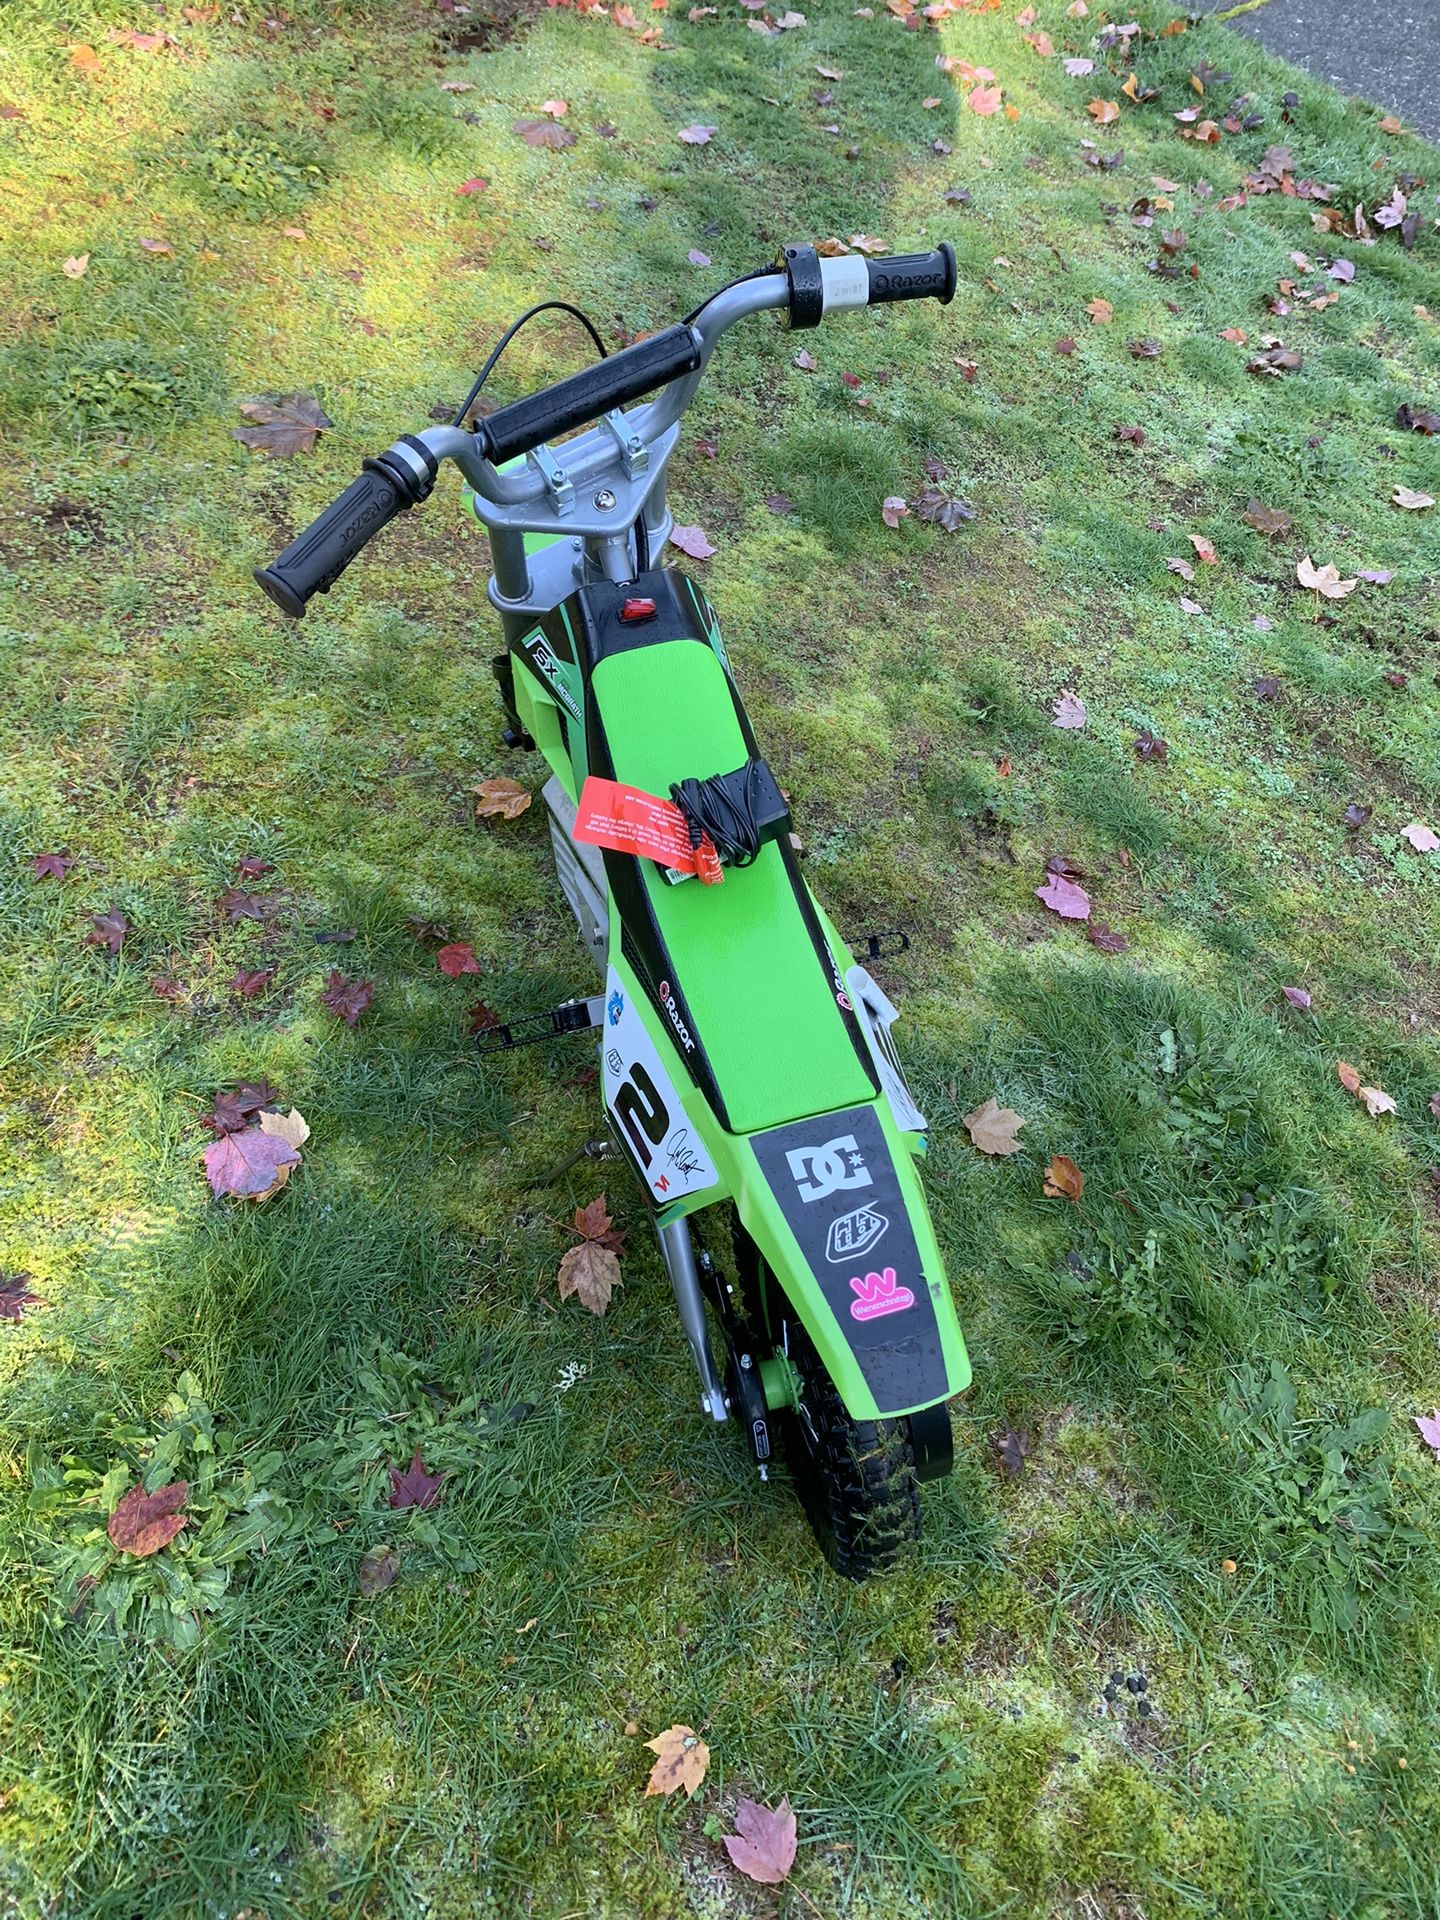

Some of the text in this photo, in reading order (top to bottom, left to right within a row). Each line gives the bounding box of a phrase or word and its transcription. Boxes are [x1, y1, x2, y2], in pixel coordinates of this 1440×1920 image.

[891, 273, 943, 289] Razor
[340, 501, 382, 548] Razor
[532, 646, 561, 681] SX
[556, 683, 583, 719] MCGRATH
[665, 998, 696, 1053] Razor
[614, 1062, 670, 1170] 2
[785, 1134, 874, 1204] DC
[850, 1267, 896, 1302] W
